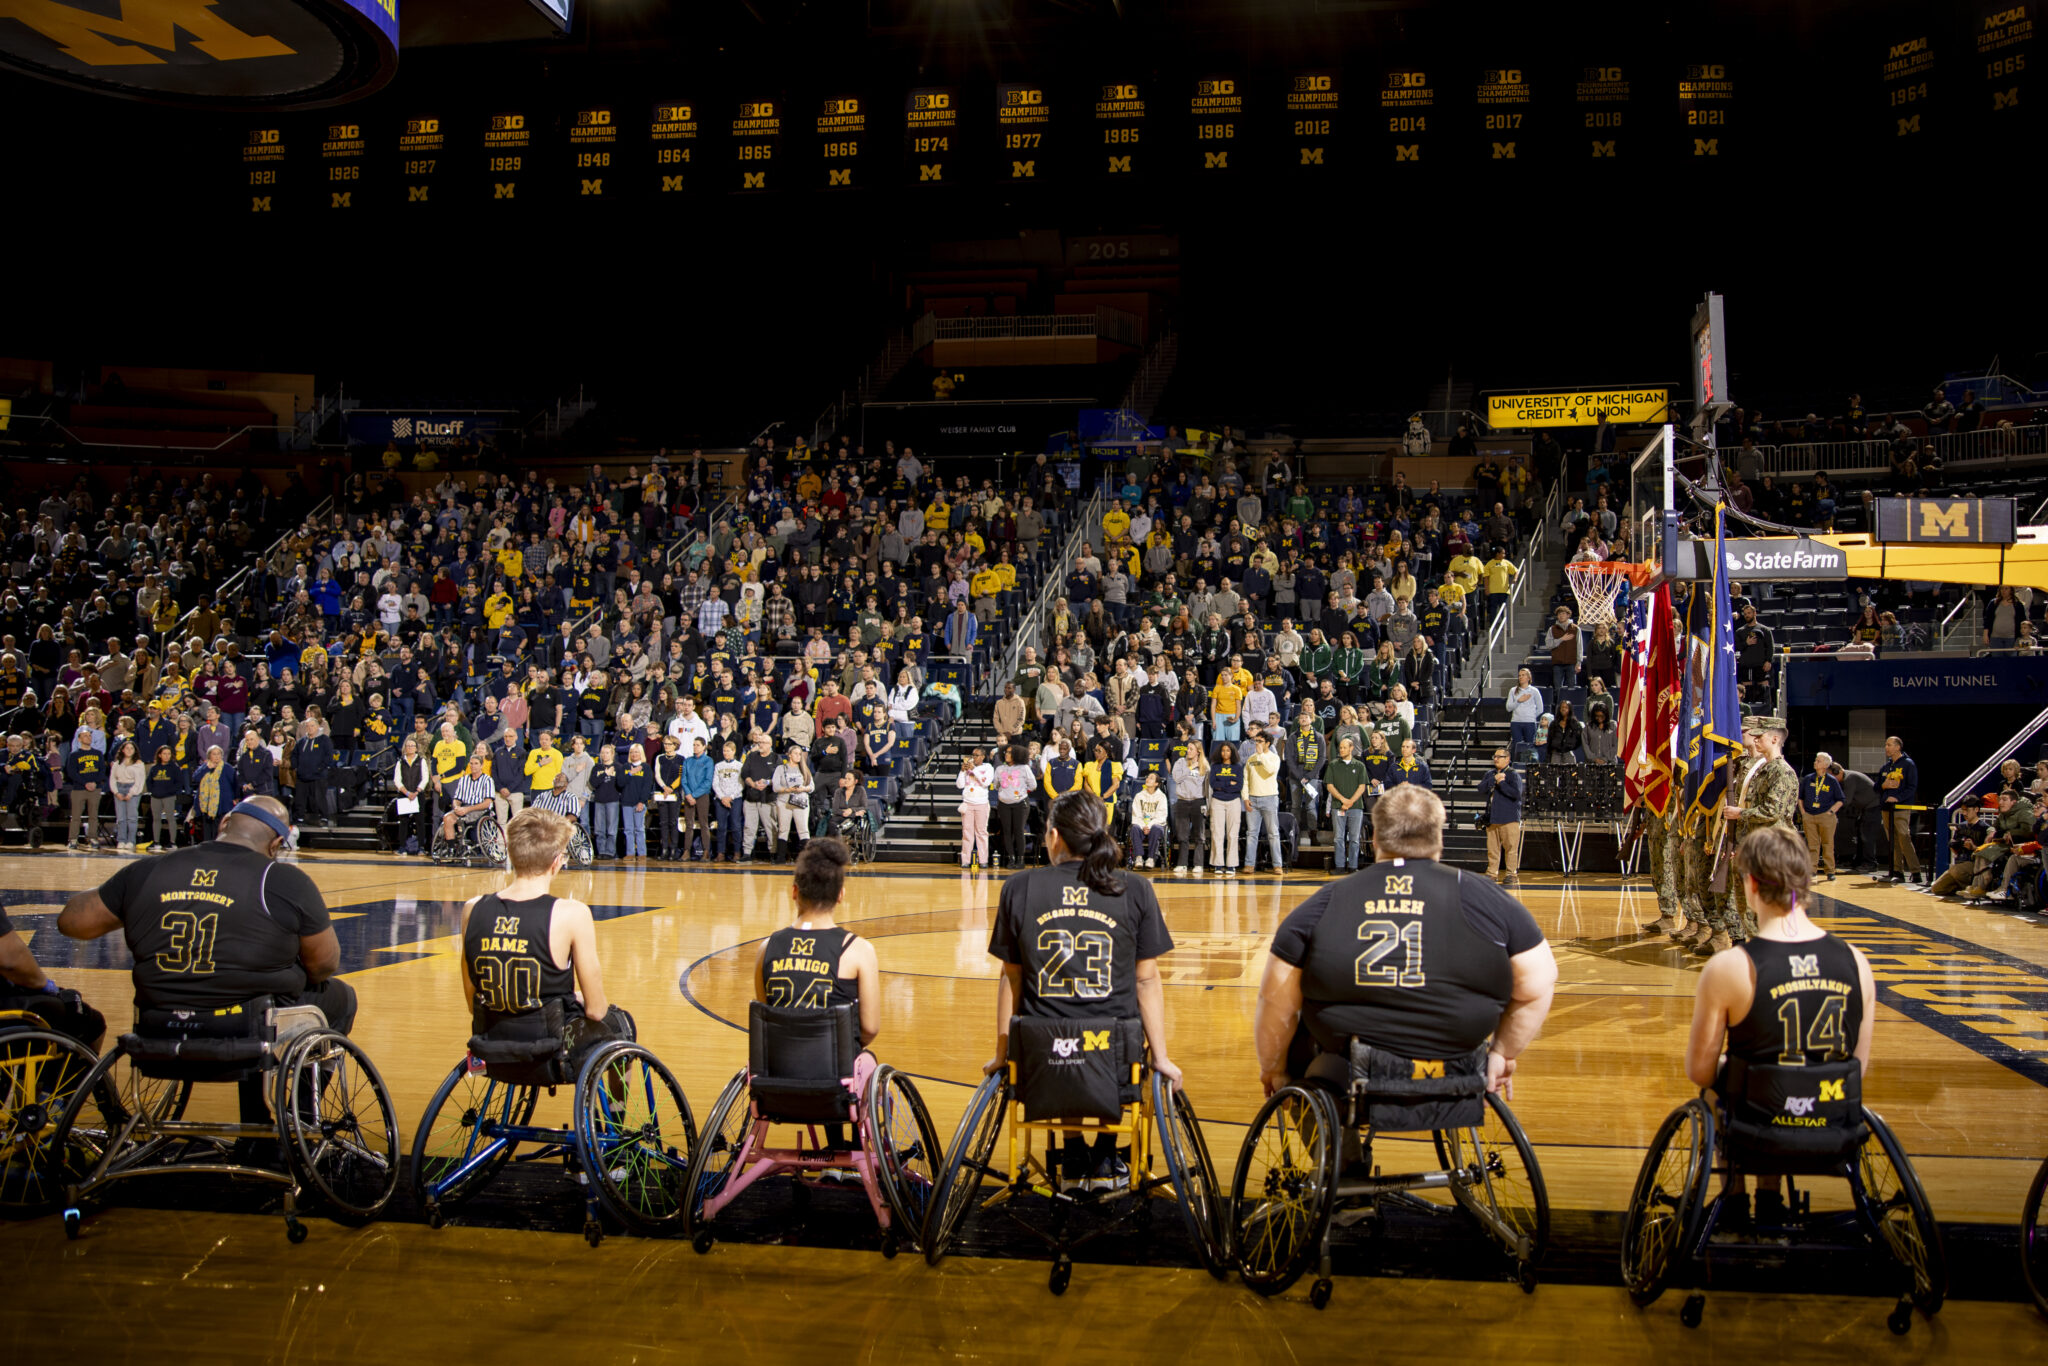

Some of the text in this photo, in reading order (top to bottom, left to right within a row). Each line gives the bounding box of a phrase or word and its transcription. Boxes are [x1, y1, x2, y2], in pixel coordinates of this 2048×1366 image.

[1984, 5, 2026, 31] NCAA
[1977, 29, 2006, 46] FINAL
[2007, 19, 2032, 36] FOUR
[1889, 36, 1928, 60] NCAA
[1883, 58, 1910, 74] FINAL
[1911, 49, 1935, 66] FOUR
[1986, 54, 2025, 80] 1965
[1381, 88, 1434, 99] CHAMPIONS
[1477, 89, 1530, 97] CHAMPIONS
[1577, 87, 1630, 95] CHAMPIONS
[1679, 81, 1733, 91] CHAMPIONS
[1890, 81, 1928, 107] 1964
[1191, 96, 1241, 107] CHAMPIONS
[1287, 91, 1339, 102] CHAMPIONS
[1992, 86, 2020, 112] M
[1000, 104, 1049, 117] CHAMPIONS
[1095, 100, 1145, 111] CHAMPIONS
[733, 118, 780, 129] CHAMPIONS
[818, 113, 865, 125] CHAMPIONS
[908, 109, 956, 121] CHAMPIONS
[1485, 113, 1523, 130] 2017
[1585, 111, 1622, 128] 2018
[1687, 109, 1725, 126] 2021
[571, 127, 616, 138] CHAMPIONS
[652, 121, 697, 132] CHAMPIONS
[1198, 123, 1235, 140] 1986
[1294, 119, 1330, 136] 2012
[1389, 116, 1427, 133] 2014
[1896, 113, 1921, 137] M
[400, 134, 444, 145] CHAMPIONS
[485, 131, 530, 142] CHAMPIONS
[1005, 132, 1042, 149] 1977
[1103, 127, 1140, 144] 1985
[243, 145, 285, 155] CHAMPIONS
[323, 140, 364, 151] CHAMPIONS
[737, 144, 772, 161] 1965
[823, 141, 858, 158] 1966
[913, 136, 949, 153] 1974
[1395, 144, 1420, 162] M
[1491, 141, 1516, 160] M
[1591, 140, 1616, 158] M
[1693, 138, 1719, 157] M
[489, 156, 522, 172] 1929
[577, 152, 611, 168] 1948
[657, 147, 691, 164] 1964
[1204, 151, 1228, 169] M
[1299, 147, 1324, 165] M
[329, 165, 360, 181] 1926
[404, 159, 437, 175] 1927
[919, 163, 943, 182] M
[1011, 160, 1036, 179] M
[1107, 155, 1132, 174] M
[249, 169, 276, 185] 1921
[661, 174, 684, 193] M
[743, 171, 766, 189] M
[828, 167, 852, 187] M
[407, 185, 429, 203] M
[493, 182, 516, 200] M
[580, 178, 603, 196] M
[251, 195, 272, 213] M
[331, 191, 352, 209] M
[1088, 242, 1129, 260] 205
[1492, 392, 1664, 409] UNIVERSITY OF MICHIGAN
[1517, 405, 1631, 420] CREDIT UNION
[415, 420, 465, 435] Ruoff
[940, 425, 1017, 435] WEISER FAMILY CLUB
[1919, 502, 1969, 537] M
[908, 639, 922, 650] M
[1892, 674, 1999, 688] BLAVIN TUNNEL
[875, 734, 882, 744] 5
[899, 740, 909, 749] M
[1148, 743, 1160, 751] M
[1149, 763, 1160, 771] M
[867, 780, 878, 789] M
[191, 868, 219, 887] M
[1384, 874, 1413, 896] M
[160, 890, 235, 908] MONTGOMERY
[1061, 886, 1089, 906] M
[1364, 899, 1425, 916] SALEH
[494, 916, 520, 936] M
[1036, 908, 1118, 929] DELGADO CORNEJO
[155, 911, 219, 974] 31
[480, 937, 529, 954] DAME
[789, 936, 817, 957] M
[1354, 918, 1427, 989] 21
[771, 957, 830, 976] MANIGO
[1037, 929, 1113, 998] 23
[1788, 953, 1820, 978] M
[473, 955, 542, 1014] 30
[1769, 979, 1853, 1000] PROSHLYAKOV
[1777, 995, 1848, 1067] 14
[1082, 1030, 1111, 1051] M
[1048, 1058, 1086, 1066] CLUB SPORT
[1411, 1058, 1446, 1080] M
[1818, 1078, 1846, 1102] M
[1771, 1115, 1828, 1127] ALLSTAR
